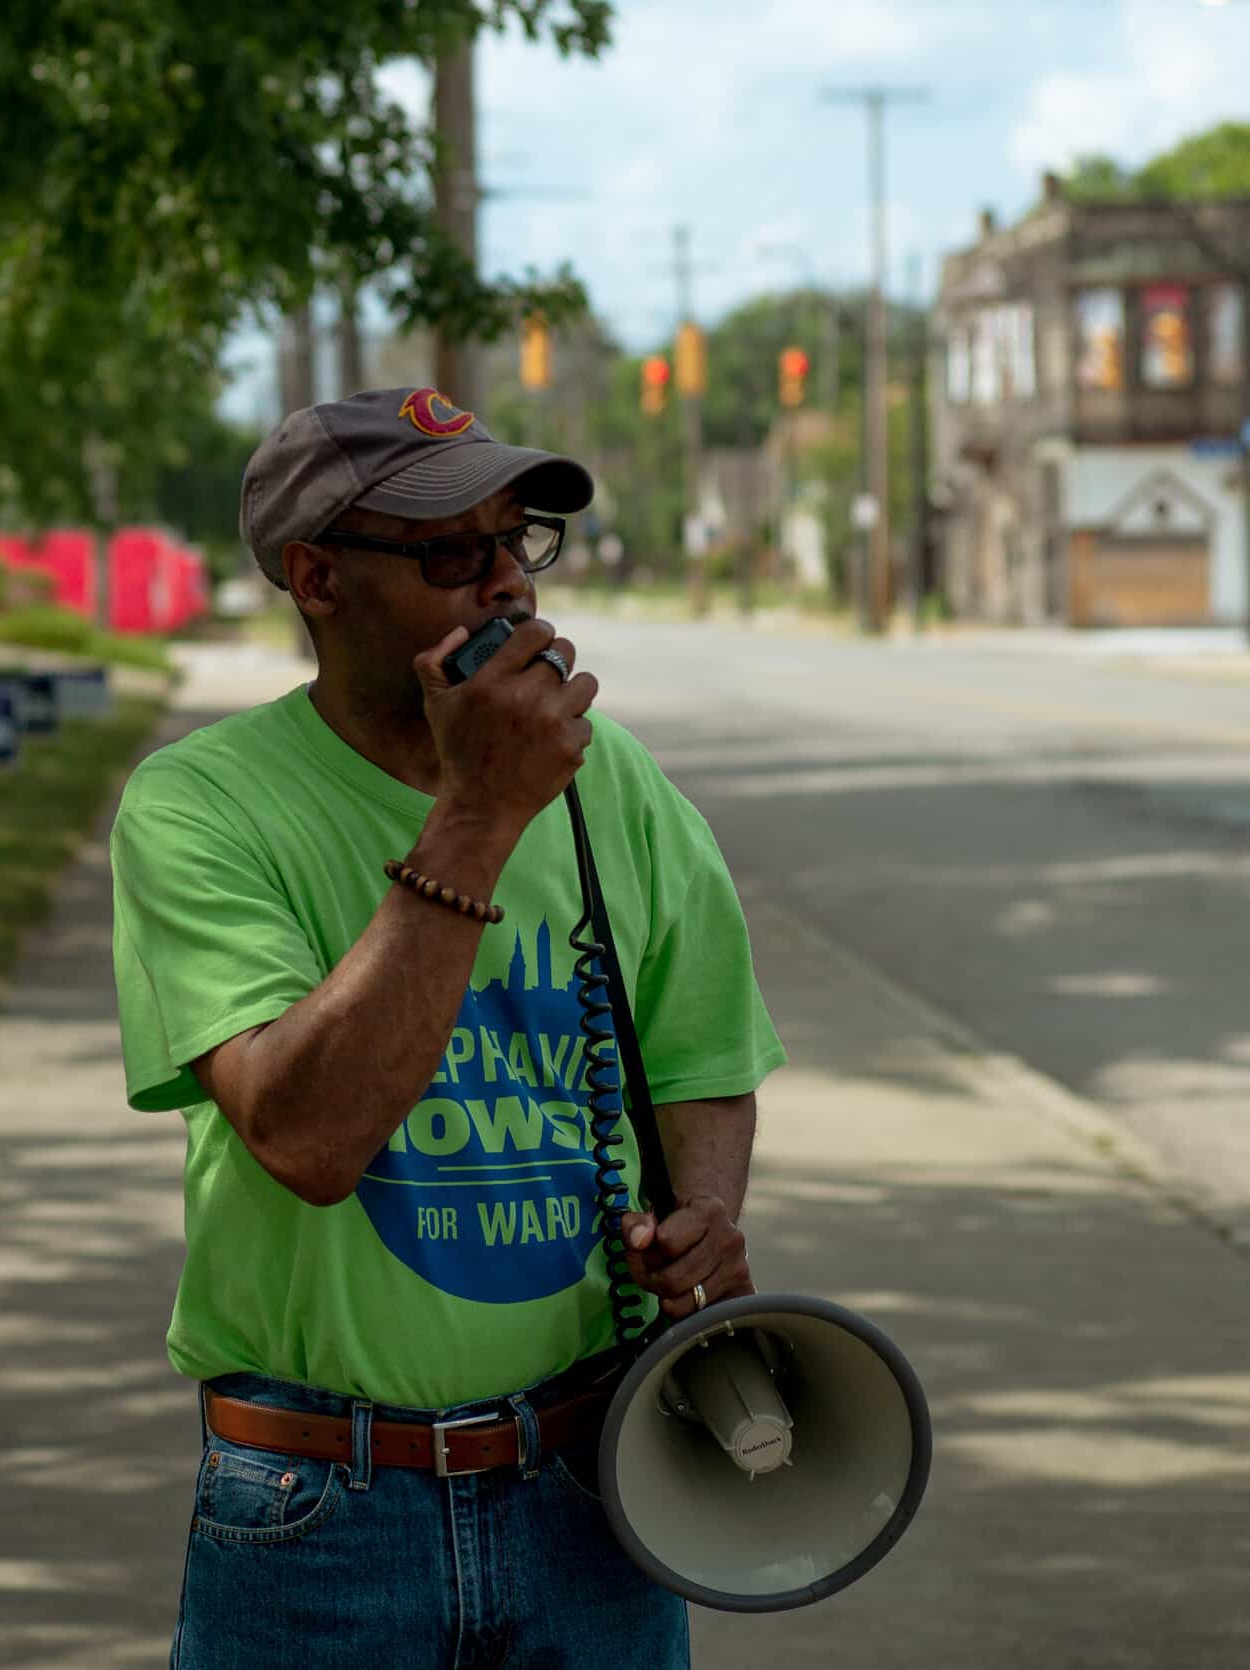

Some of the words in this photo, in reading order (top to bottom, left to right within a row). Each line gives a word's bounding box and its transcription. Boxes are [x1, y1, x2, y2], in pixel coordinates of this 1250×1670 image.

[387, 1095, 599, 1156] OWS
[417, 1206, 458, 1241] FOR
[477, 1195, 582, 1247] WARD
